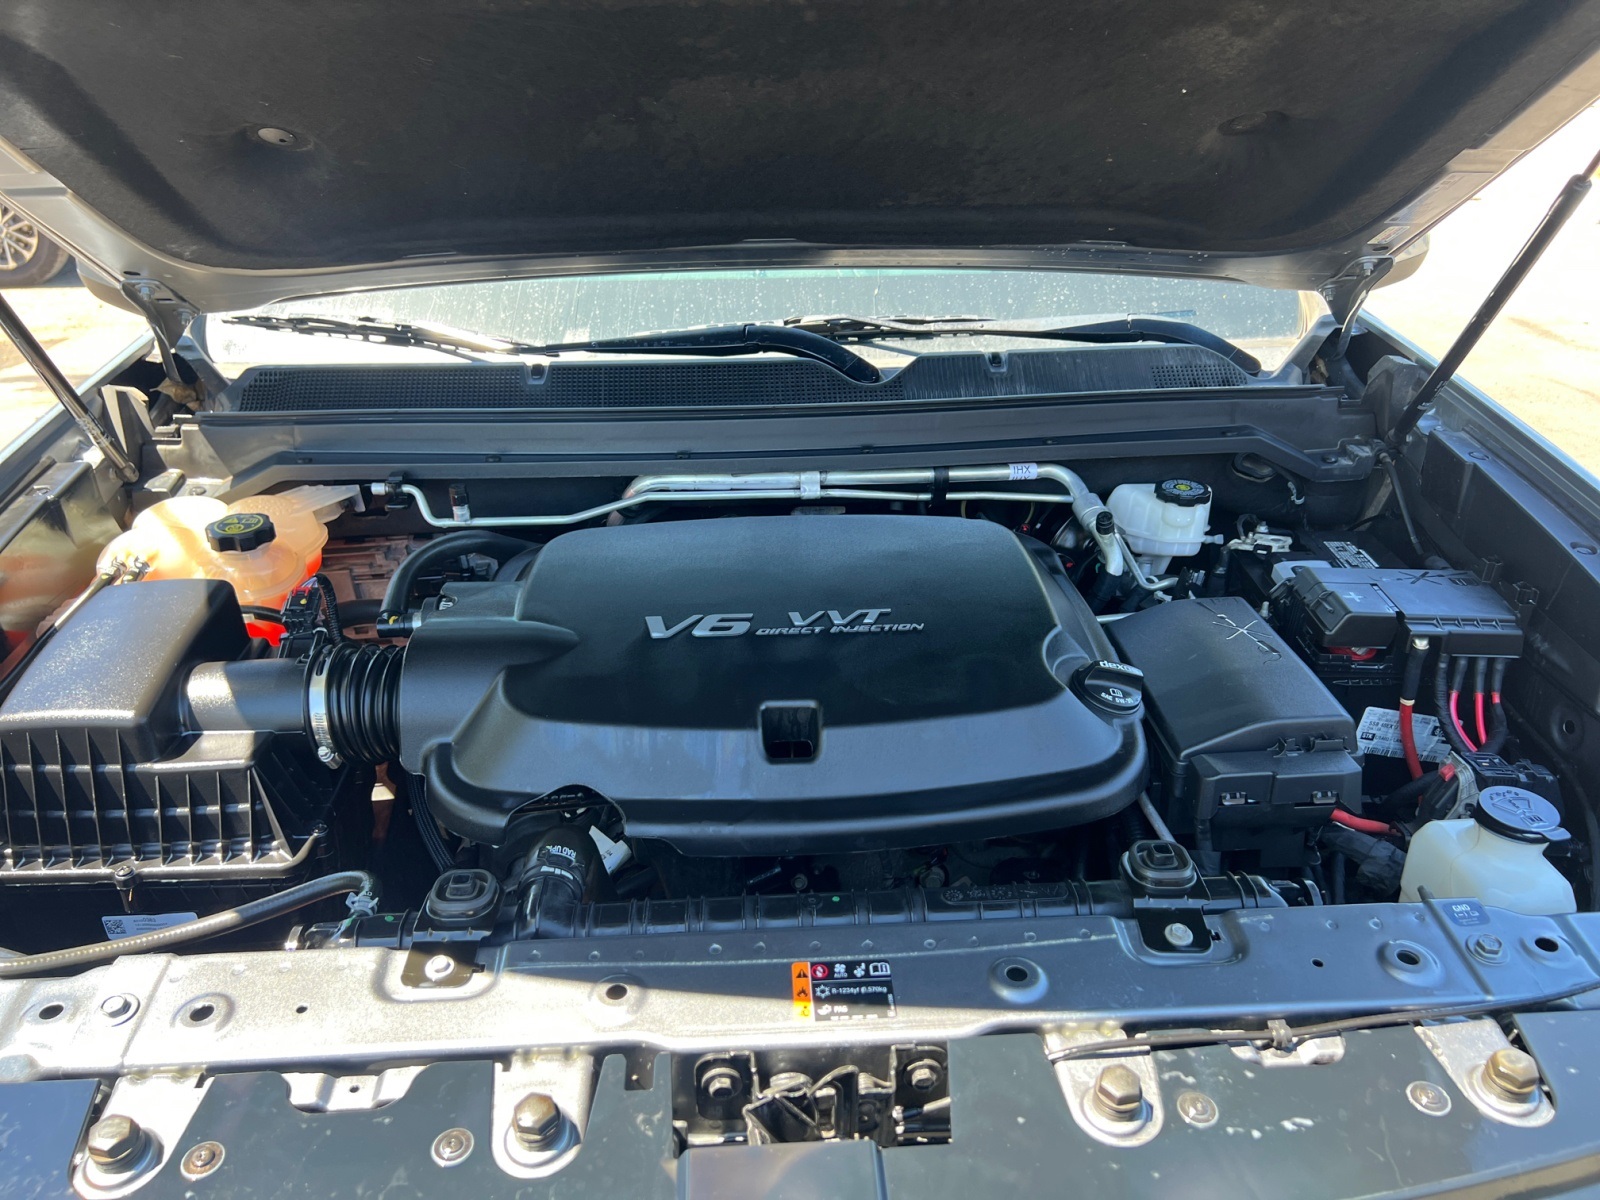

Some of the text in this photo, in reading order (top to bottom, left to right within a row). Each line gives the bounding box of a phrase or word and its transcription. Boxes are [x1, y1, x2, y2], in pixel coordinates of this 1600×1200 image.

[645, 608, 891, 639] V6 VVT
[755, 622, 925, 636] DIRECT INJECTION
[562, 847, 577, 858] RAD
[1452, 904, 1471, 912] GND
